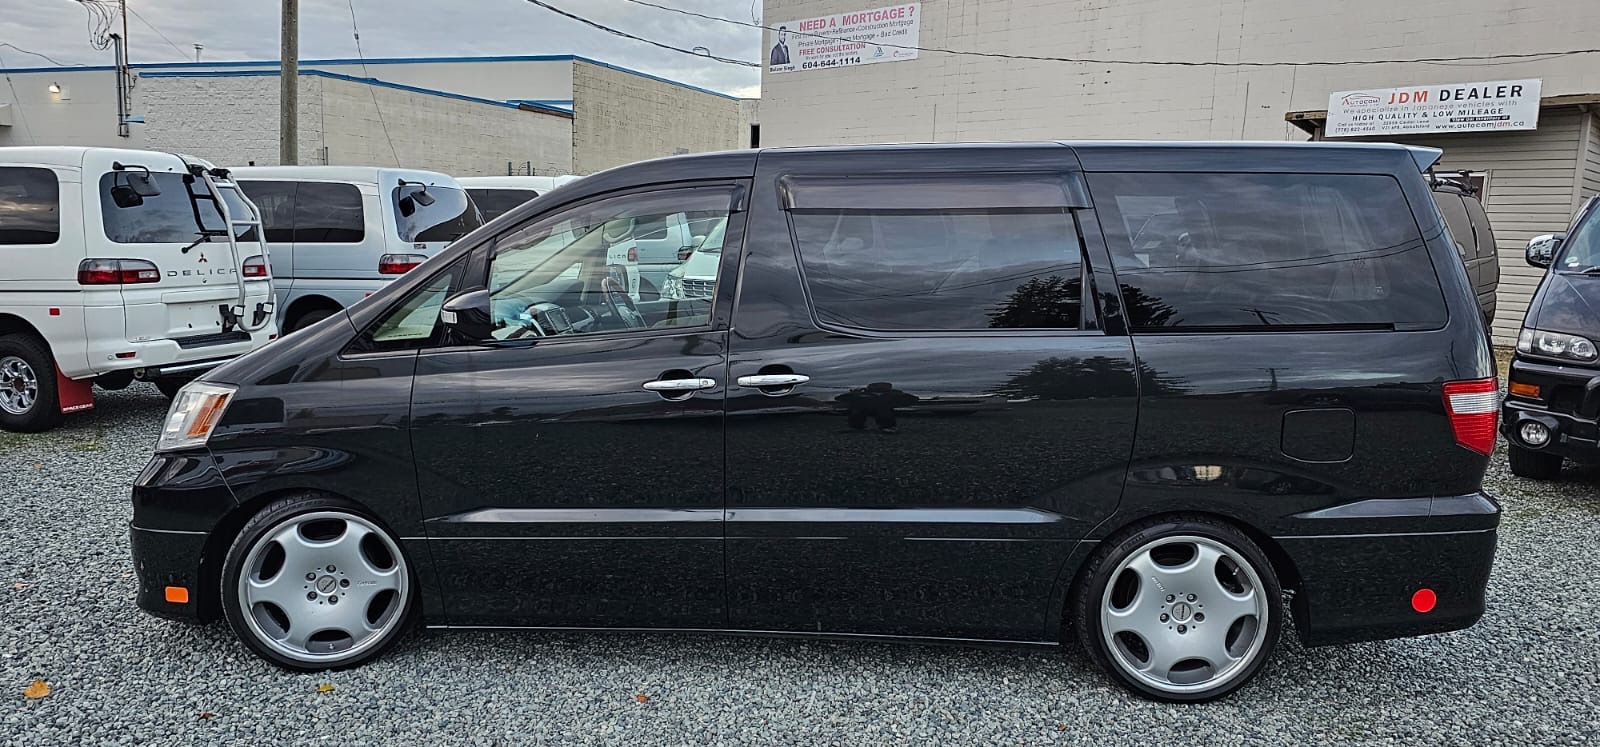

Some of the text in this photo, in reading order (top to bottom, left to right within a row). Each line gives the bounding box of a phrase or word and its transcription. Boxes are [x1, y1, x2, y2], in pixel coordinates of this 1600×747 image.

[800, 18, 826, 32] NEED
[830, 17, 836, 27] A
[842, 7, 905, 26] MORTGAGE
[799, 48, 815, 56] FREE
[816, 42, 866, 54] CONSULTATION
[802, 56, 861, 69] 604-644-1114
[1388, 90, 1428, 105] JDM
[1439, 85, 1523, 102] DEALER
[1412, 103, 1454, 112] Japanese
[1378, 112, 1418, 121] QUALITY
[1458, 108, 1504, 116] MILEAGE
[1435, 120, 1524, 129] www.autocomjdm.ca
[167, 268, 237, 277] DELICA
